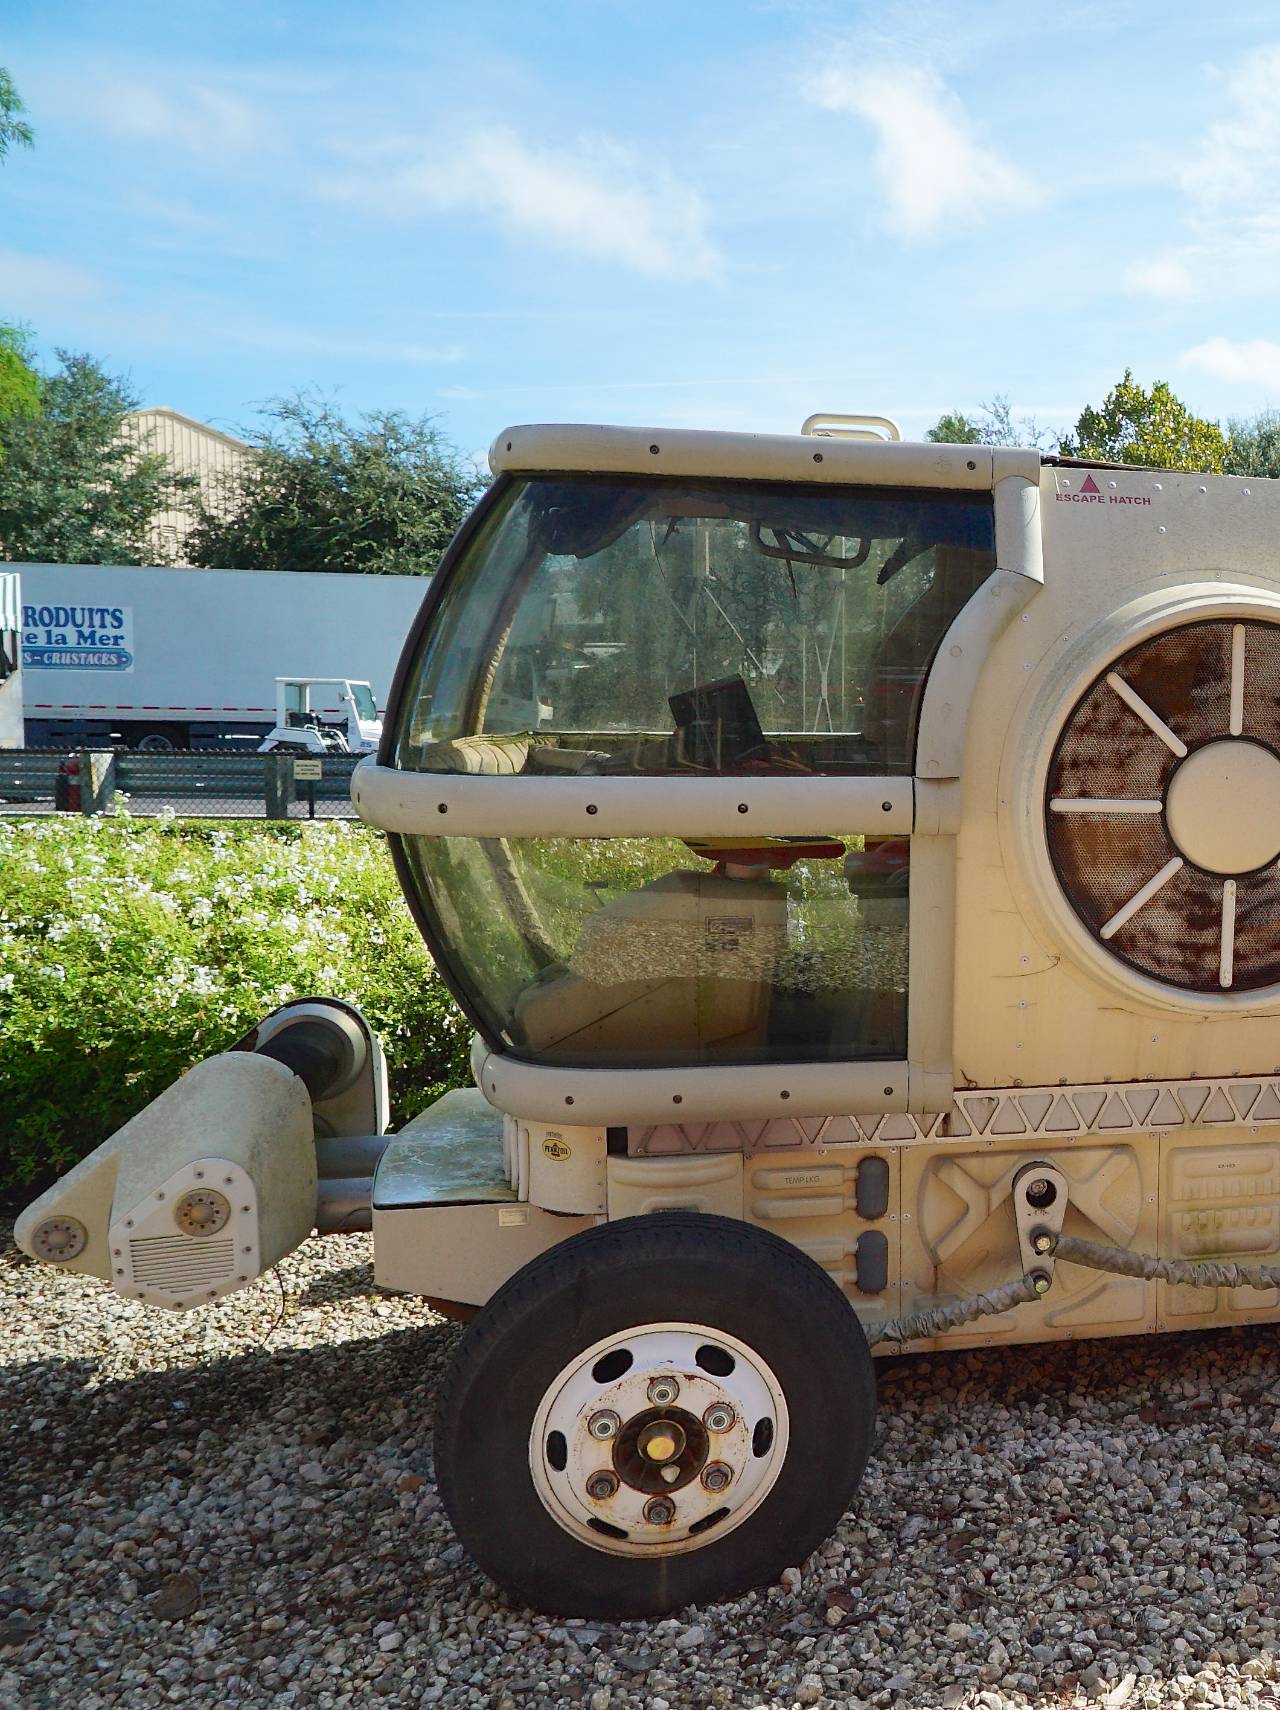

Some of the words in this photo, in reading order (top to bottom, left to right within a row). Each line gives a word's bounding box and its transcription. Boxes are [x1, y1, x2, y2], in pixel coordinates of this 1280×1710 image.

[1055, 493, 1106, 504] ESCAPE
[1109, 496, 1151, 506] HATCH
[44, 630, 67, 646] la
[75, 630, 125, 647] Mer
